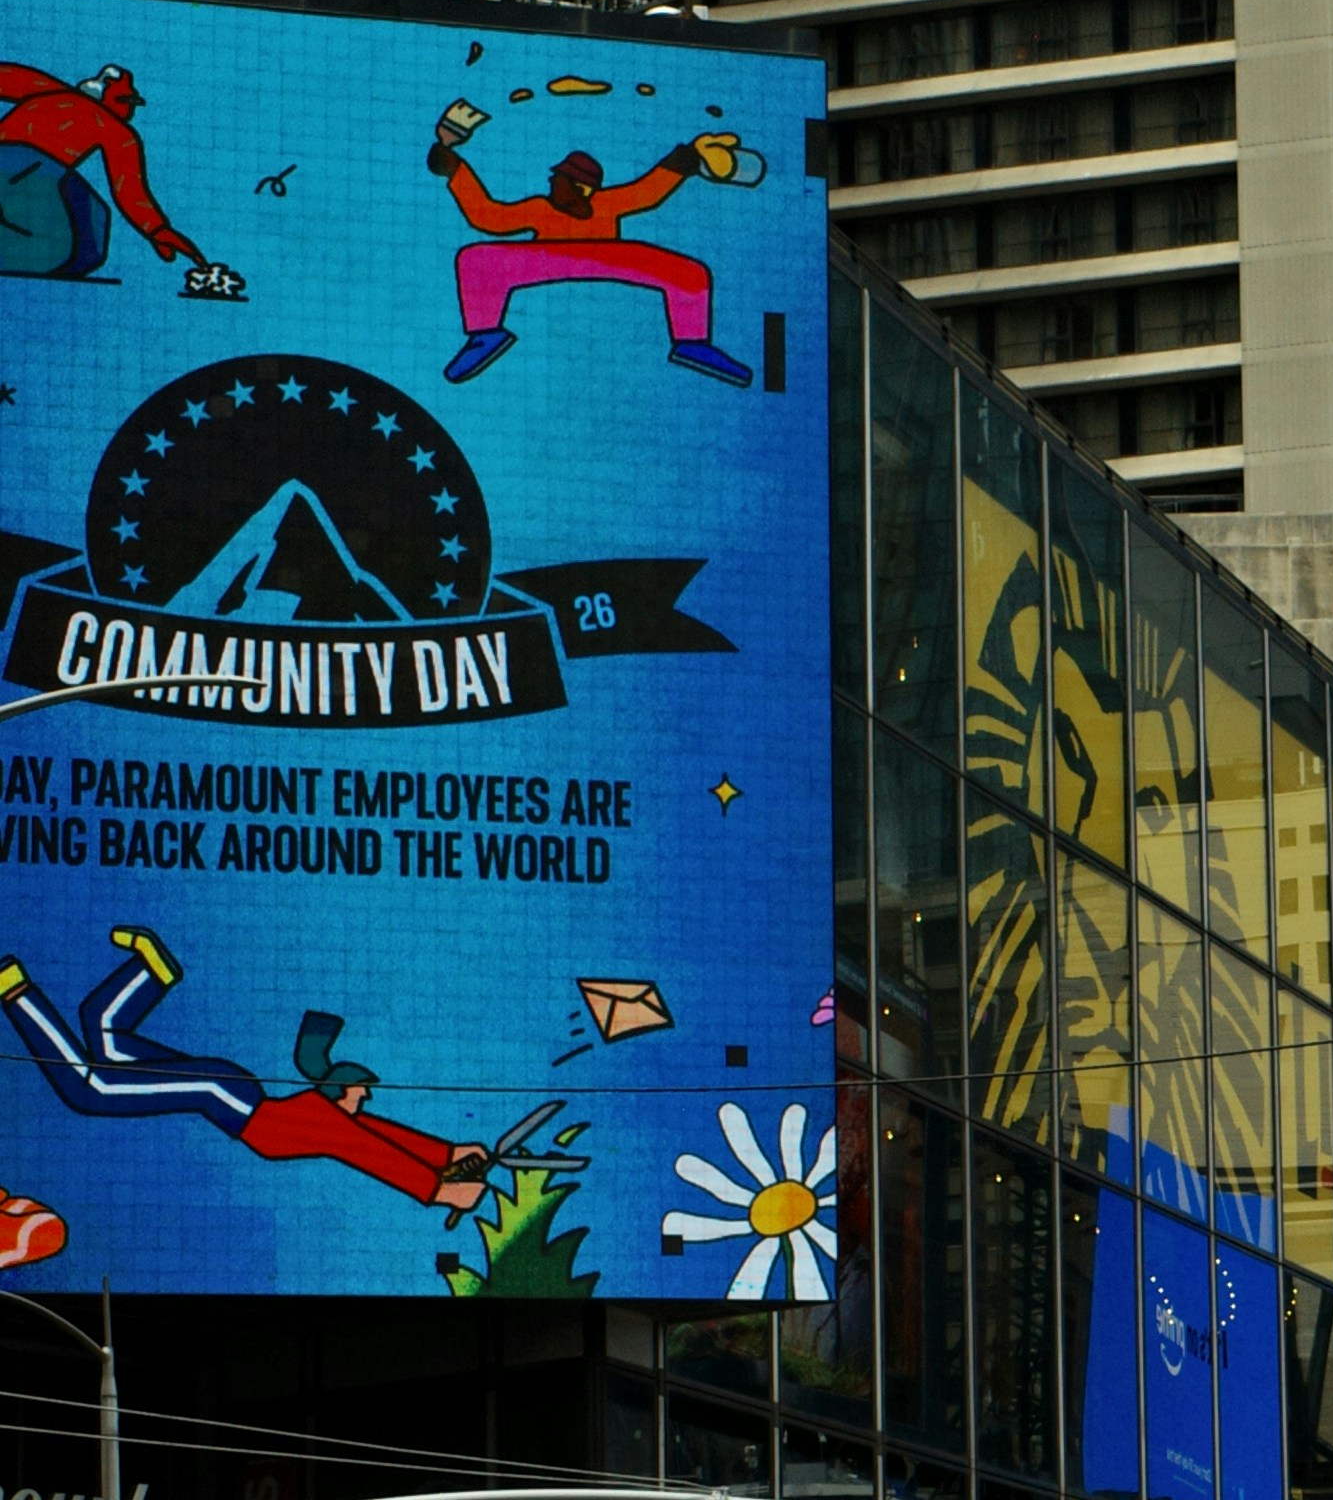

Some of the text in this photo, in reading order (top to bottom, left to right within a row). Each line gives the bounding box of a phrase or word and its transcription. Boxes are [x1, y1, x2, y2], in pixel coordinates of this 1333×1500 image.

[573, 592, 616, 633] 26
[56, 609, 514, 718] COMMUNITY DAY
[0, 753, 633, 828] AY, PARAMOUNT EMPLOYEES ARE
[101, 819, 206, 872] BACK
[218, 824, 383, 877] AROUND
[393, 830, 464, 882] THE
[474, 834, 611, 886] WORLD
